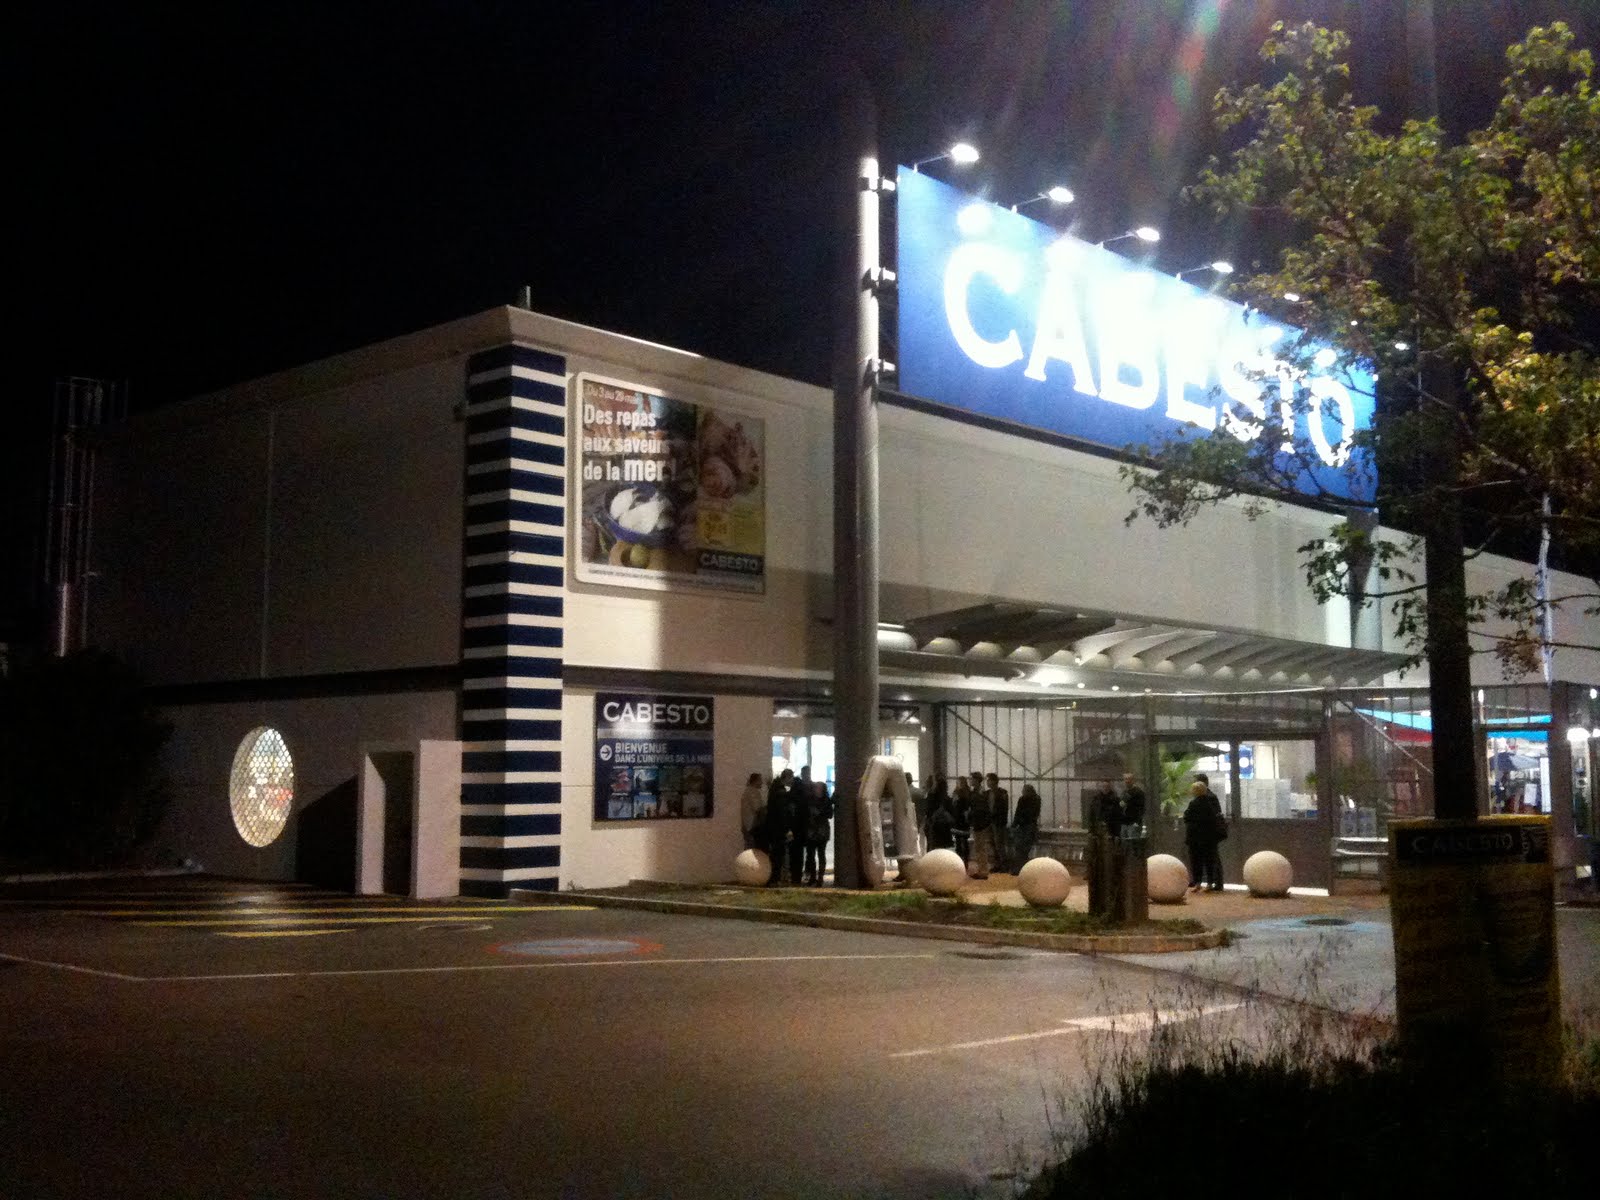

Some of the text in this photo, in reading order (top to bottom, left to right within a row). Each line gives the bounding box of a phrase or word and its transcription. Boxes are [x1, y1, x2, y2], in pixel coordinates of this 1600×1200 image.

[943, 240, 1356, 467] CABESTO
[584, 404, 657, 431] Des repas
[583, 437, 611, 452] aux
[583, 460, 602, 481] de
[606, 460, 620, 481] la
[700, 552, 759, 571] CABESTO
[603, 701, 710, 724] CABESTO
[615, 742, 667, 754] BIENVENUE
[615, 753, 635, 763] DANS
